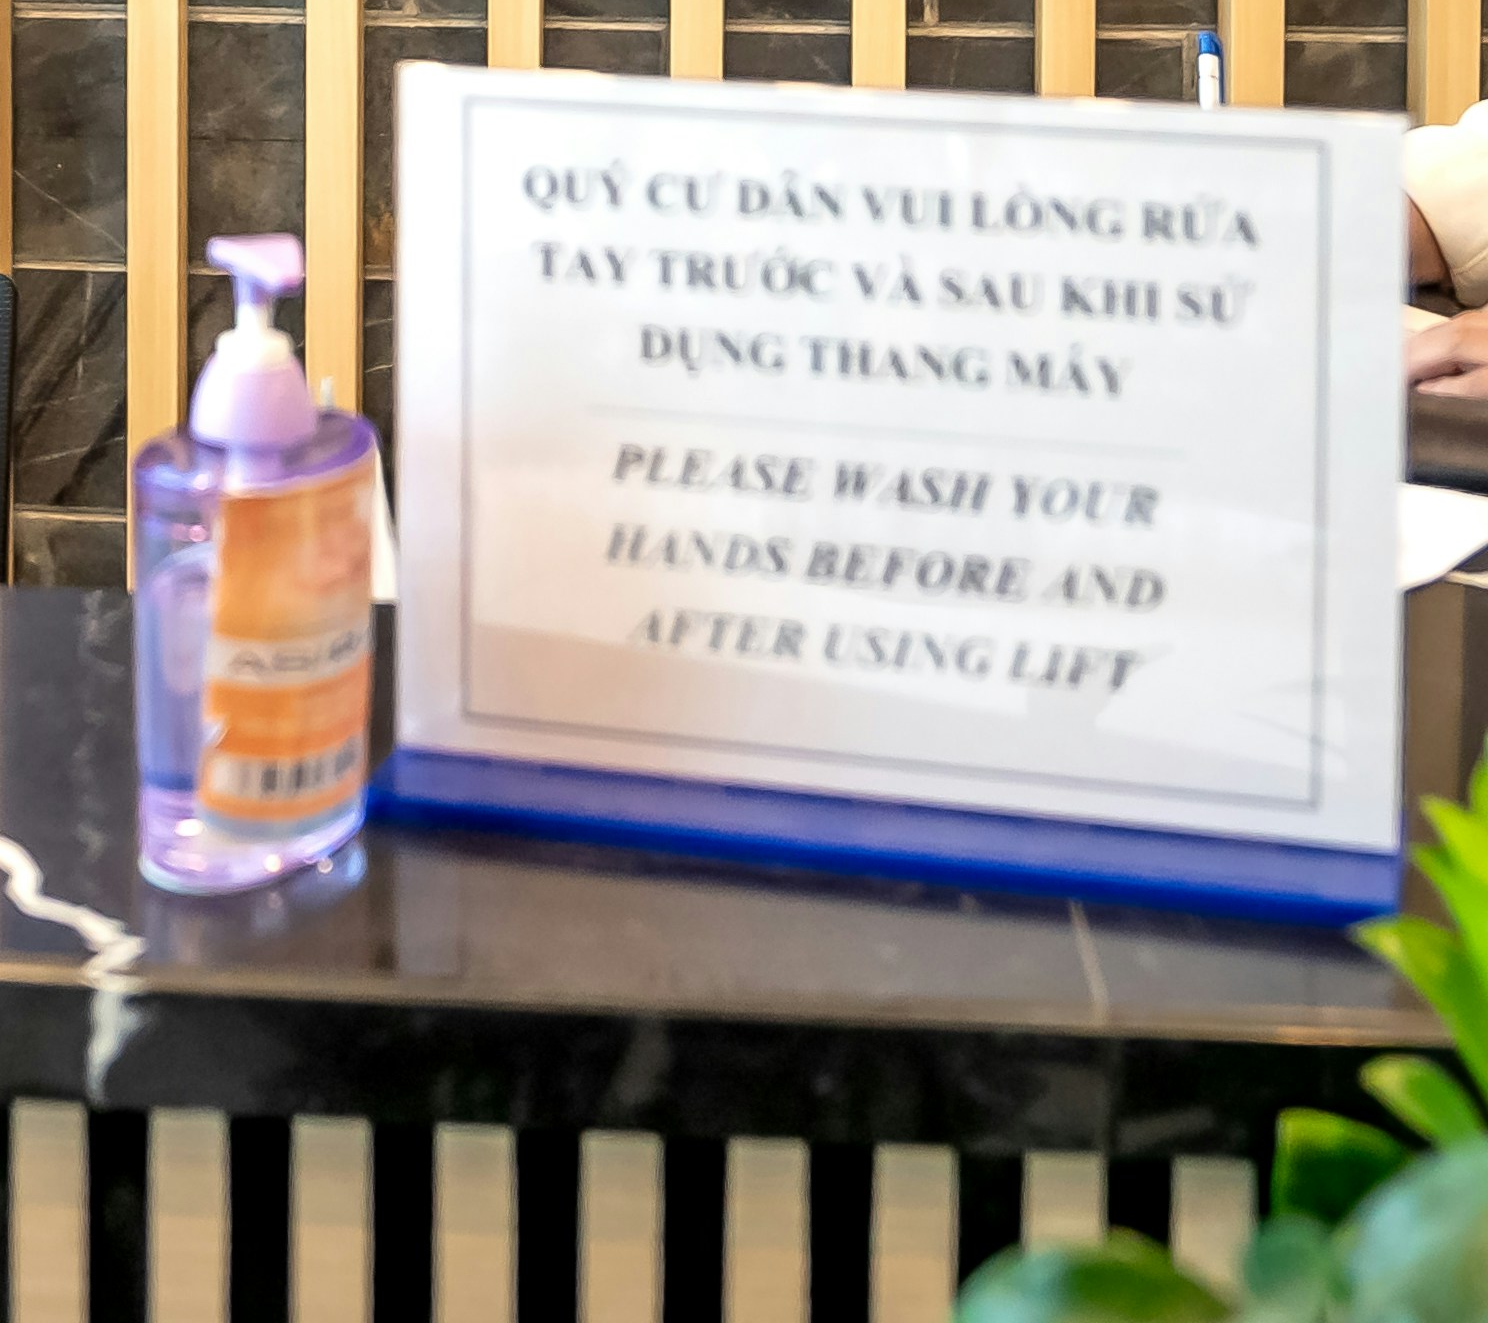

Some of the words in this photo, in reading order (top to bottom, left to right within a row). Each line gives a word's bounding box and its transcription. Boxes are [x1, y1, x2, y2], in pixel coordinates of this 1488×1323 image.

[523, 158, 630, 212] QUÝ
[862, 185, 952, 228] VUI
[970, 182, 1125, 241] LÒNG
[531, 241, 633, 283] TAY
[652, 246, 837, 301] TRƯỚC
[852, 255, 921, 307] VÀ
[938, 267, 1045, 316] SAU
[1060, 275, 1160, 320] KHI
[640, 324, 786, 377] DỤNG
[800, 334, 990, 388] THANG
[1007, 342, 1133, 397] MÁY
[614, 443, 815, 502] PLEASE
[834, 461, 991, 516] WASH
[1013, 474, 1160, 529] YOUR
[607, 523, 794, 581] HANDS
[805, 541, 1032, 603] BEFORE
[1041, 564, 1168, 613] AND
[626, 608, 806, 662] AFTER
[824, 623, 997, 680] USING
[1008, 640, 1146, 693] LIFT
